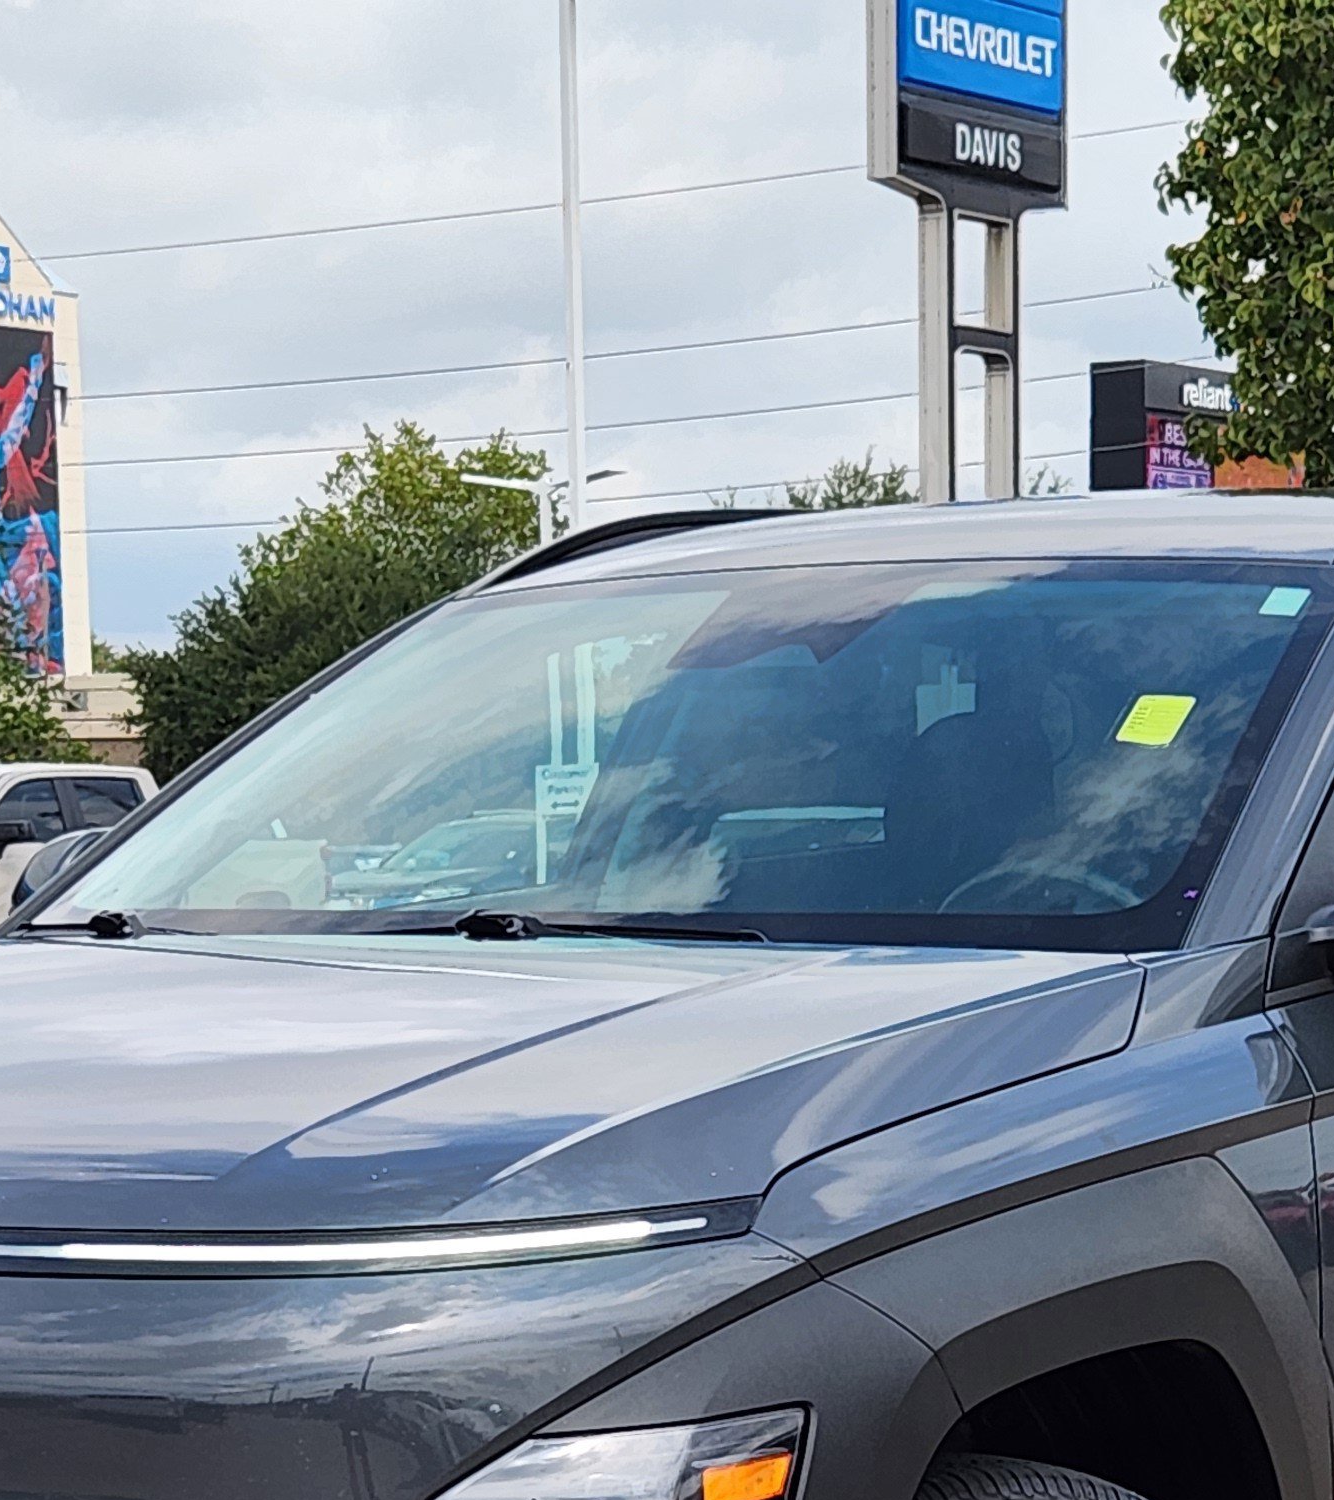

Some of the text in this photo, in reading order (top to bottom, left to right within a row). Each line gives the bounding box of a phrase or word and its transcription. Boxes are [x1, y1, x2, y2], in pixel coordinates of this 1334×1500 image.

[914, 6, 1058, 79] CHEVROLET
[954, 121, 1022, 173] DAVIS
[1182, 377, 1233, 412] reliant
[1162, 447, 1181, 467] THE
